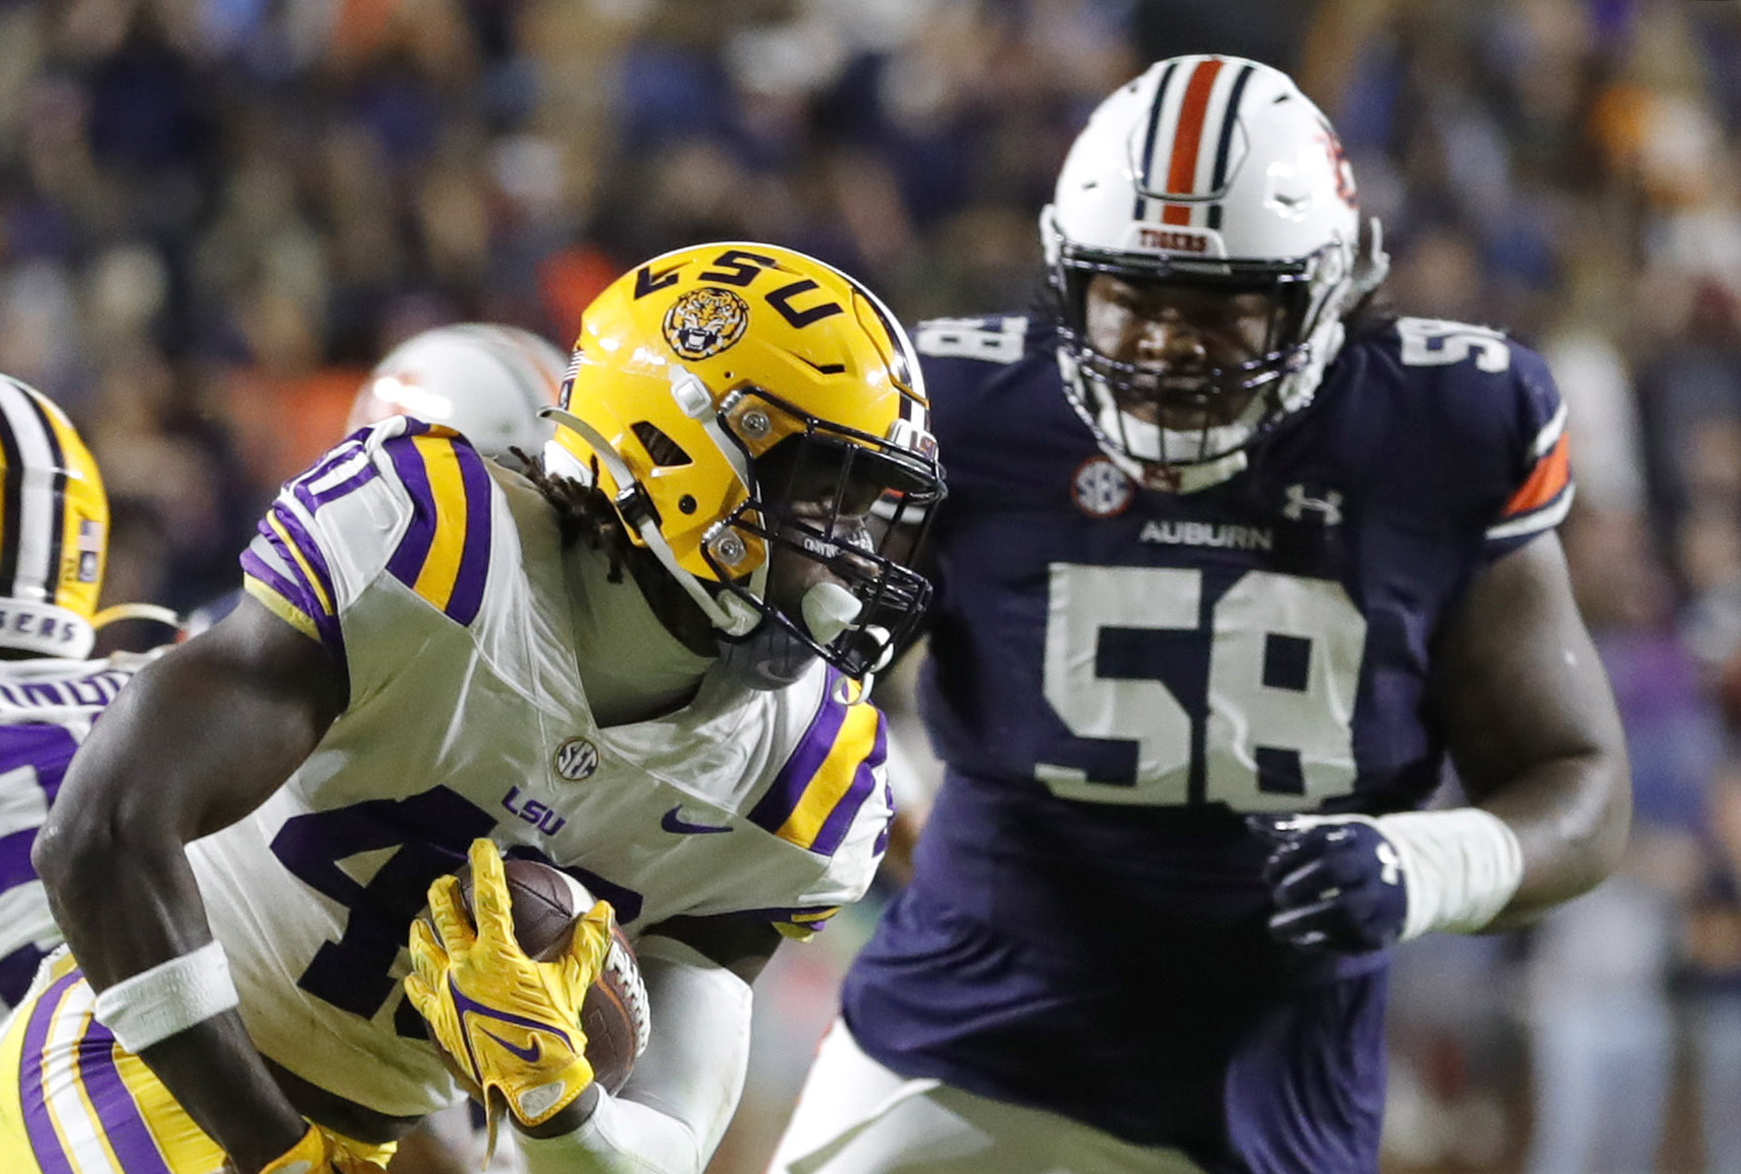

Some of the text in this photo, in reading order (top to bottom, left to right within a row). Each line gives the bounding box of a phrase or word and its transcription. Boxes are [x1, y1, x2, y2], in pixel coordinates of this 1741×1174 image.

[634, 250, 846, 330] LSU
[1139, 519, 1273, 550] AUBURN
[1034, 561, 1368, 814] 58
[558, 740, 598, 780] SEC
[501, 785, 567, 837] LSU
